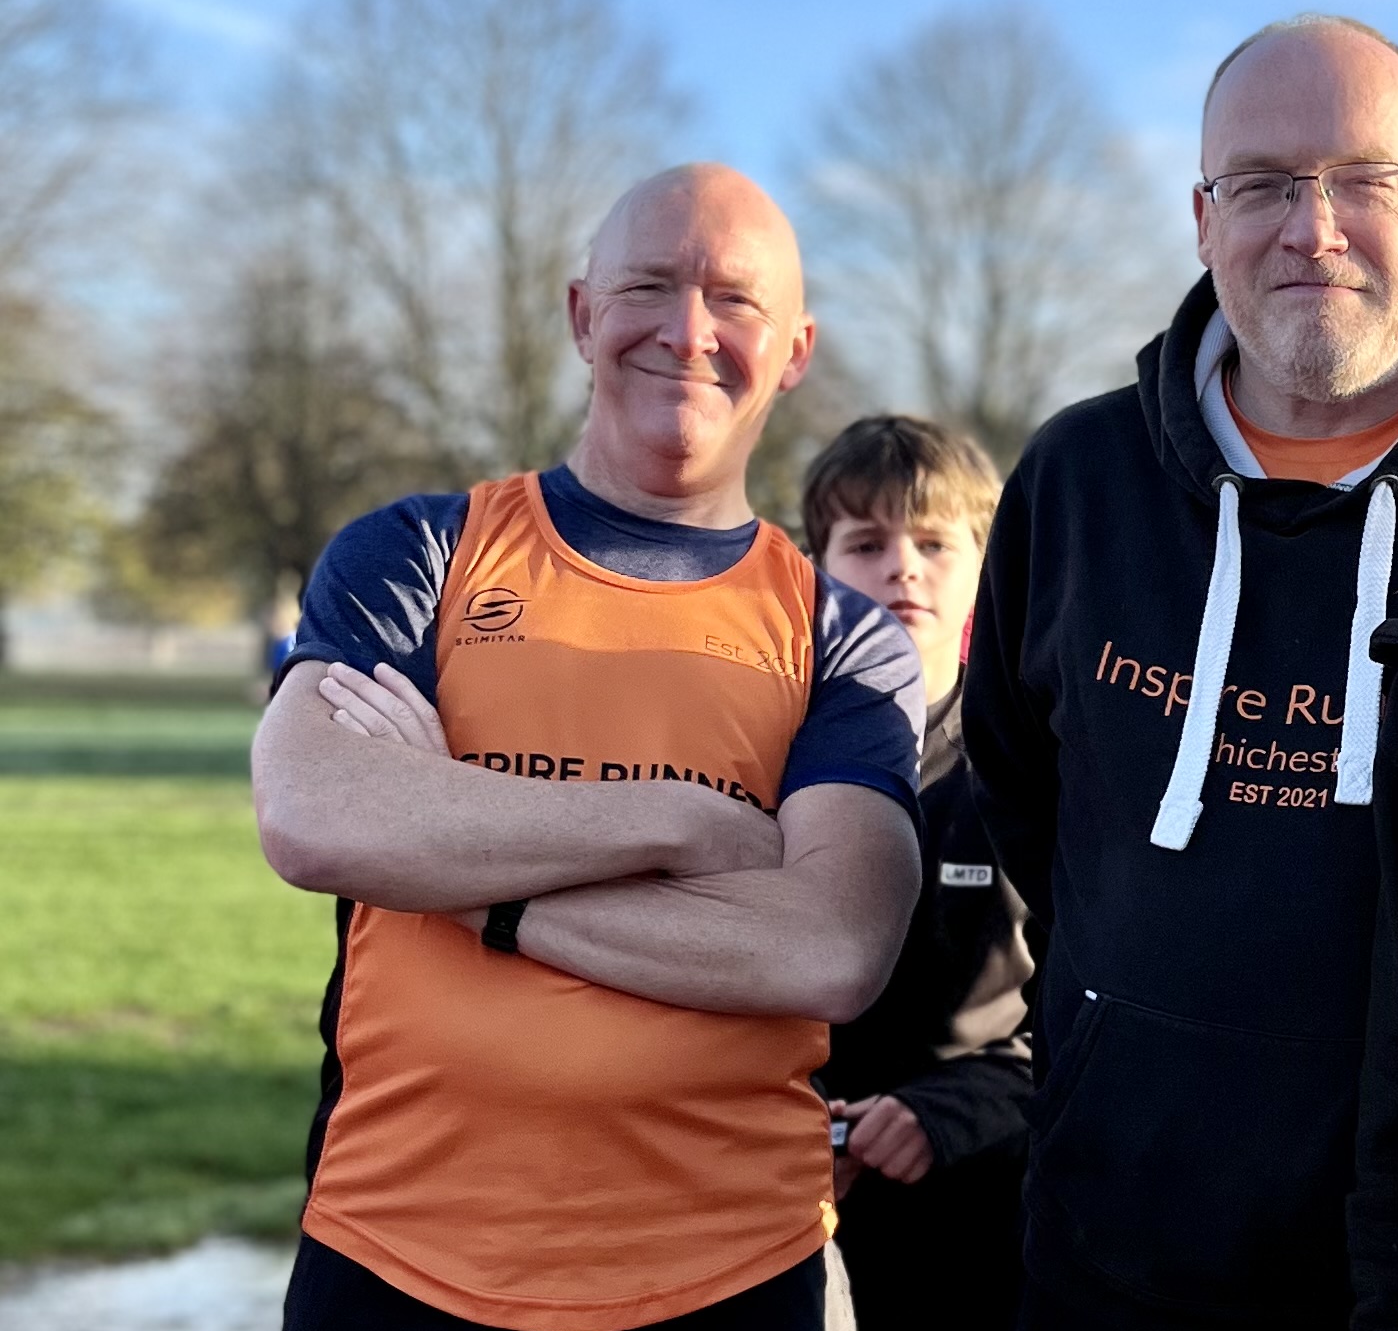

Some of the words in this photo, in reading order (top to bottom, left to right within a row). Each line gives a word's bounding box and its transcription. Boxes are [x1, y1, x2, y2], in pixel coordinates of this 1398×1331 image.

[455, 635, 526, 646] SCIMITAR
[1096, 641, 1267, 720] Inspre
[1215, 732, 1341, 773] hichest
[1229, 781, 1274, 805] EST
[1276, 786, 1329, 808] 2021
